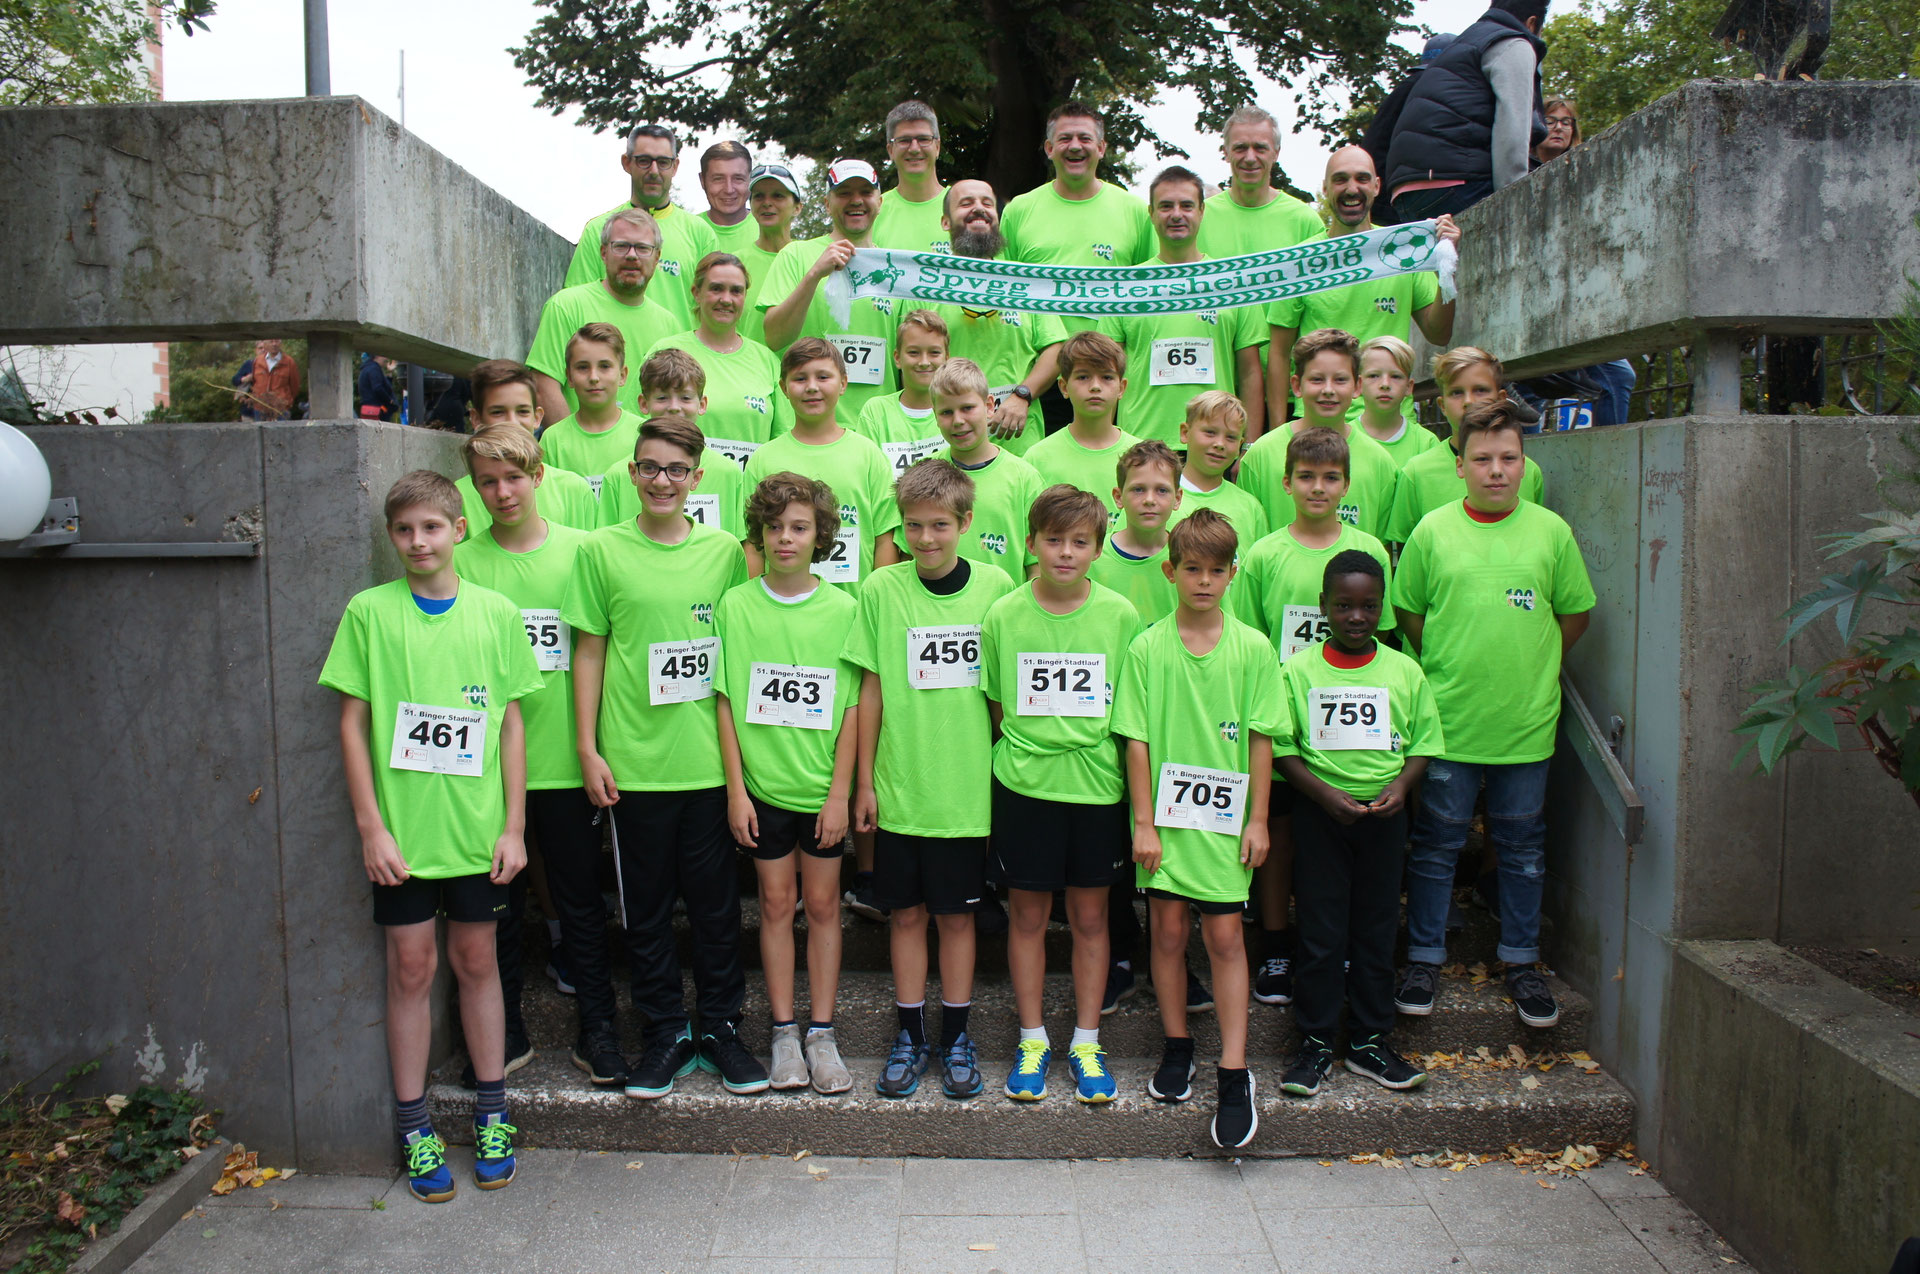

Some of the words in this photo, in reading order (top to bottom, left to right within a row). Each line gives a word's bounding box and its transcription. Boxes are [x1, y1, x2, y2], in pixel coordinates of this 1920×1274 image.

[919, 266, 1030, 298] Spvgg
[1051, 269, 1287, 298] Dietersheim
[1294, 249, 1362, 278] 1918
[843, 346, 871, 364] 67
[1167, 348, 1197, 366] 65
[710, 443, 731, 451] Binger
[925, 632, 951, 640] Binger
[666, 647, 690, 656] Binger
[691, 642, 716, 653] Stadtlauf
[919, 639, 979, 665] 456
[660, 652, 709, 680] 459
[1037, 659, 1063, 667] Binger
[1064, 659, 1100, 667] Stadtlauf
[756, 667, 768, 675] 51.
[770, 669, 795, 678] Binger
[795, 671, 830, 680] Stadtlauf
[1030, 667, 1092, 692] 512
[761, 678, 820, 705] 463
[1319, 693, 1342, 701] Binger
[1344, 692, 1377, 700] Stadtlauf
[403, 708, 417, 717] 51.
[419, 711, 446, 720] Binger
[448, 714, 482, 724] Stadtlauf
[1320, 702, 1377, 726] 759
[408, 720, 470, 750] 461
[1166, 769, 1178, 777] 51.
[1180, 771, 1206, 780] Binger
[1207, 774, 1243, 785] Stadtlauf
[1172, 780, 1233, 810] 705
